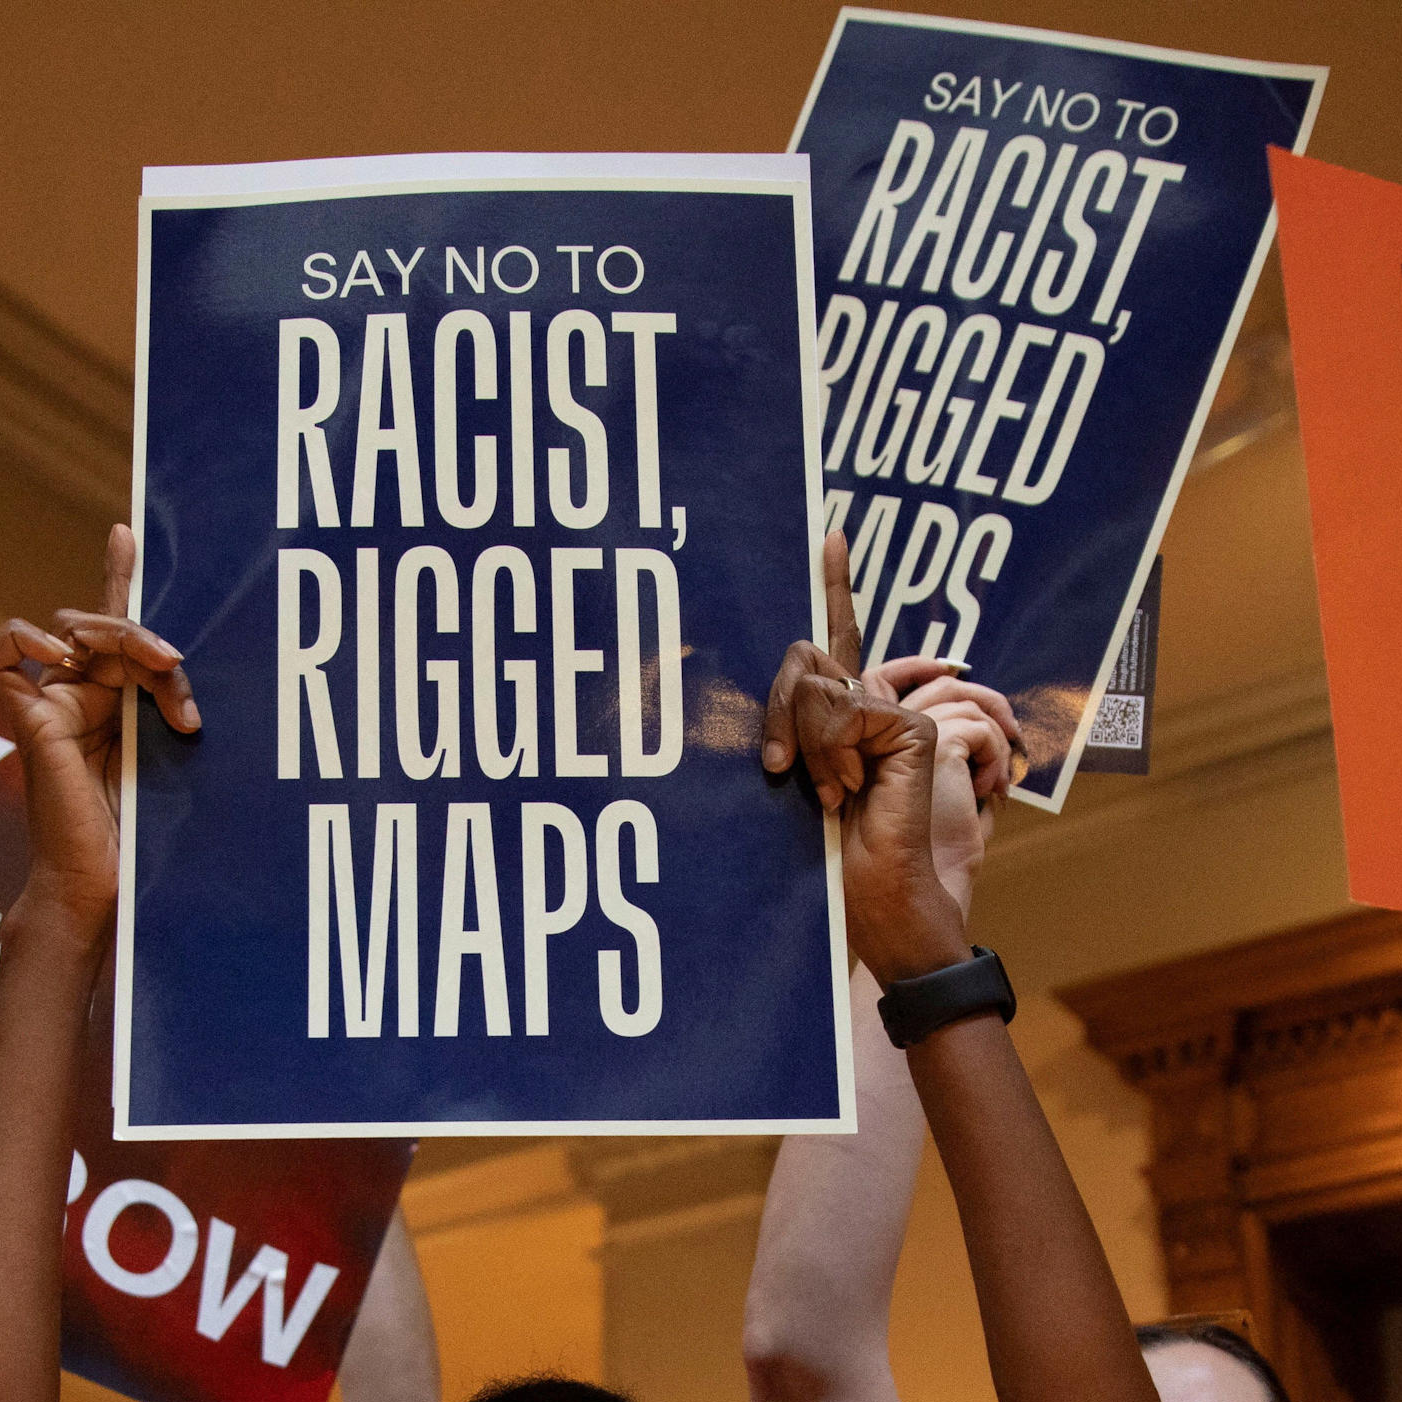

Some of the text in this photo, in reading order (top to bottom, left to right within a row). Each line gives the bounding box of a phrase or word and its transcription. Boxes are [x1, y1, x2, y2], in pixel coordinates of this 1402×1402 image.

[924, 71, 1179, 147] SAY NO TO
[301, 245, 645, 300] SAY NO TO
[837, 118, 1187, 345] RACIST,
[276, 309, 687, 551] RACIST,
[277, 545, 684, 781] RIGGED
[307, 799, 663, 1039] MAPS
